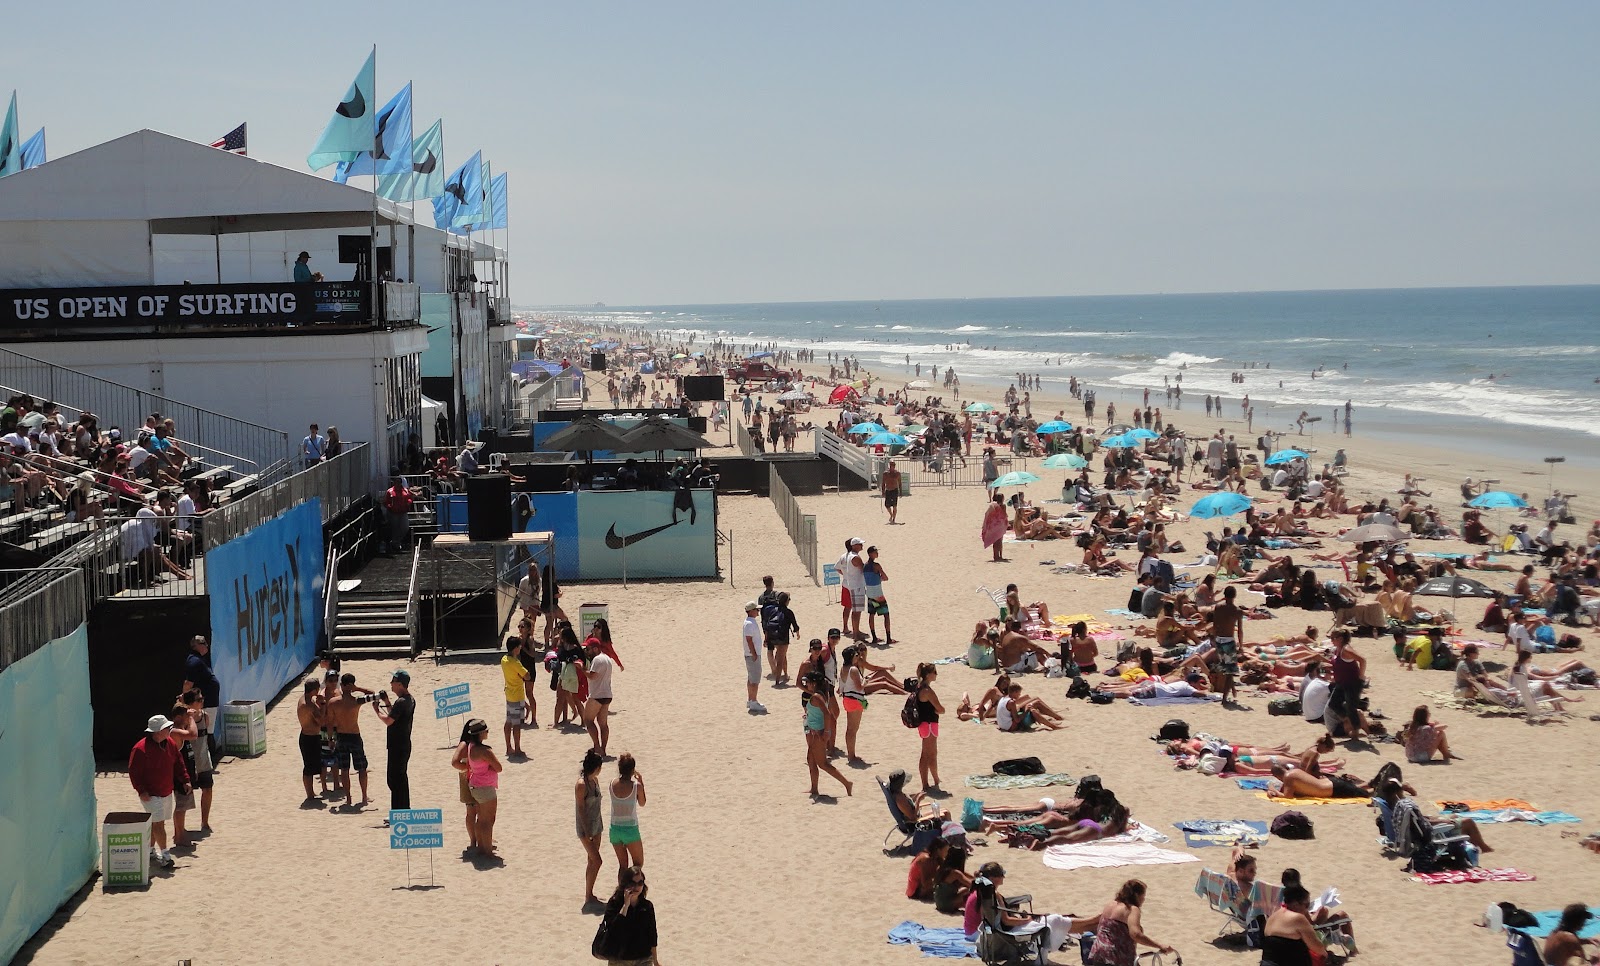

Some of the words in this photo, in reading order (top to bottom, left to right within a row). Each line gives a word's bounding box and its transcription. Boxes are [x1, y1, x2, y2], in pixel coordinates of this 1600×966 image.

[315, 290, 329, 298] US
[332, 290, 360, 298] OPEN
[13, 298, 50, 320] US
[59, 296, 128, 319] OPEN
[137, 295, 169, 317] OF
[178, 292, 297, 316] SURFING
[234, 562, 290, 673] Hurley
[435, 690, 449, 698] FREE
[449, 685, 467, 694] WATER
[451, 704, 470, 713] BOOTH
[392, 812, 410, 821] FREE
[411, 811, 438, 820] WATER
[414, 837, 440, 845] BOOTH
